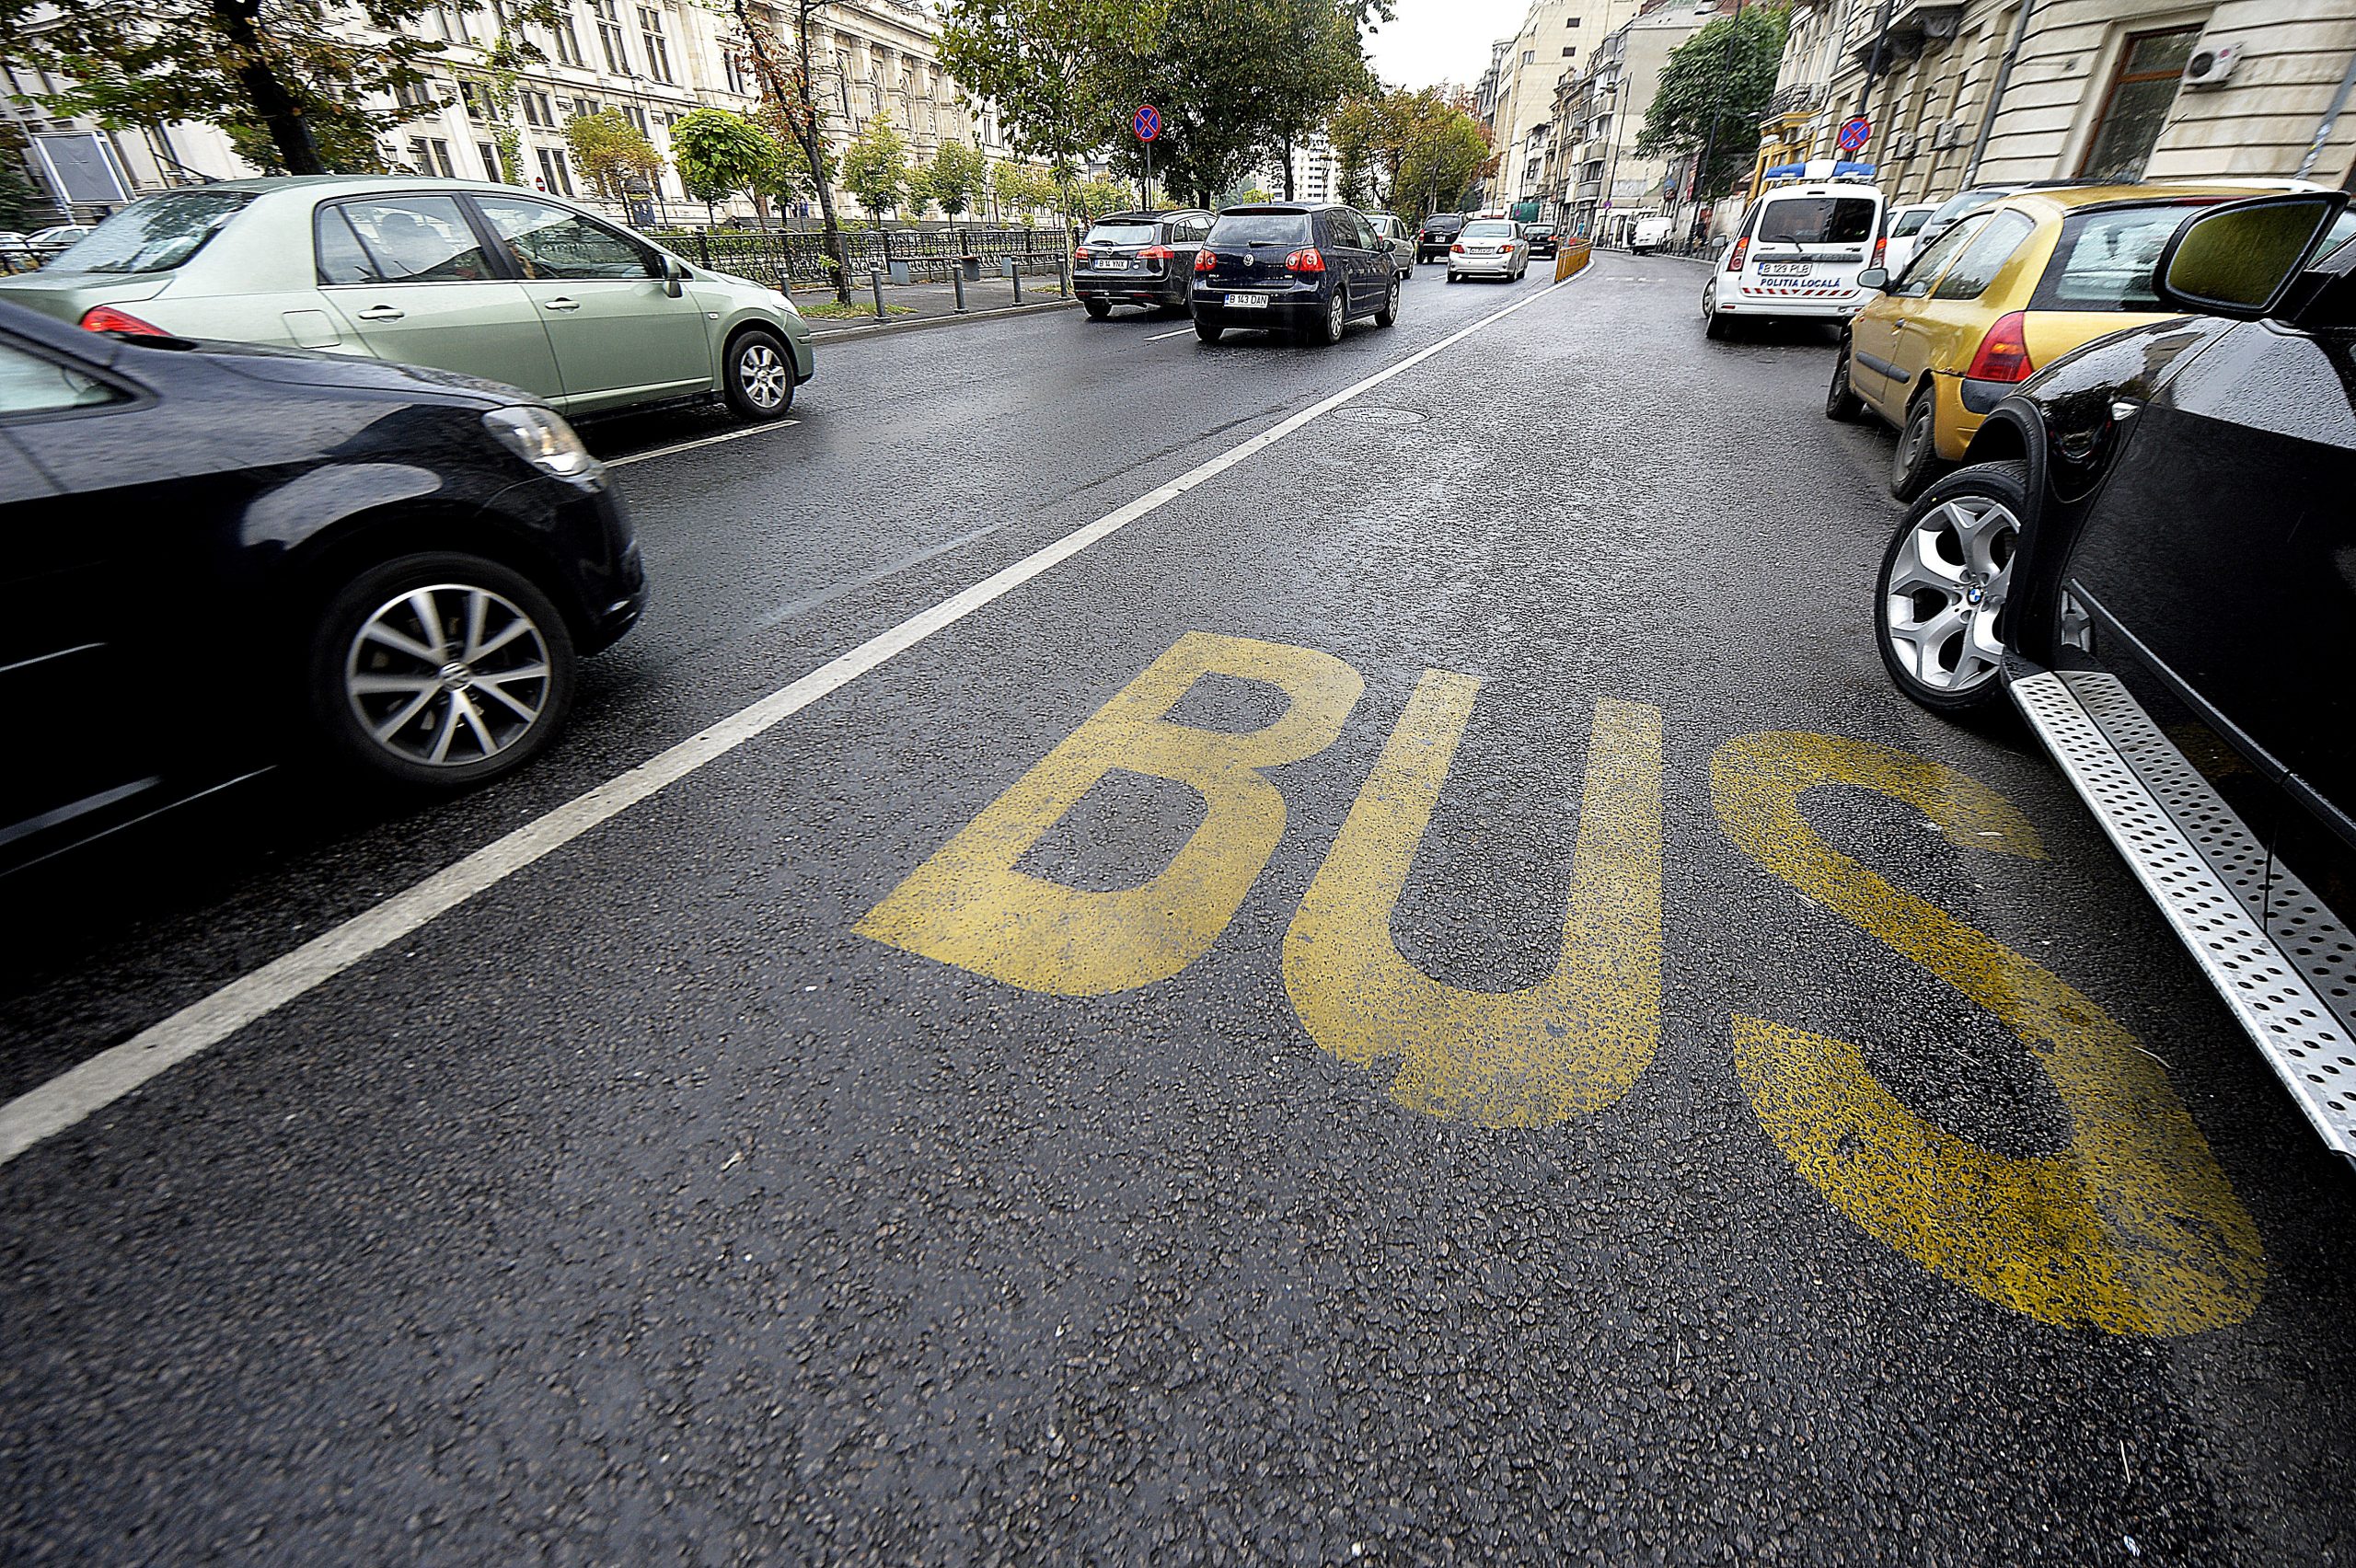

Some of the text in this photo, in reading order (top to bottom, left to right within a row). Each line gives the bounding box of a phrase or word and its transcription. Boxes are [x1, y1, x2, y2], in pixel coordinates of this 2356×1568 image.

[1763, 264, 1771, 273] B
[1789, 264, 1809, 273] PLB
[1230, 294, 1267, 305] B 143 DAN
[856, 632, 2266, 1336] BUS
